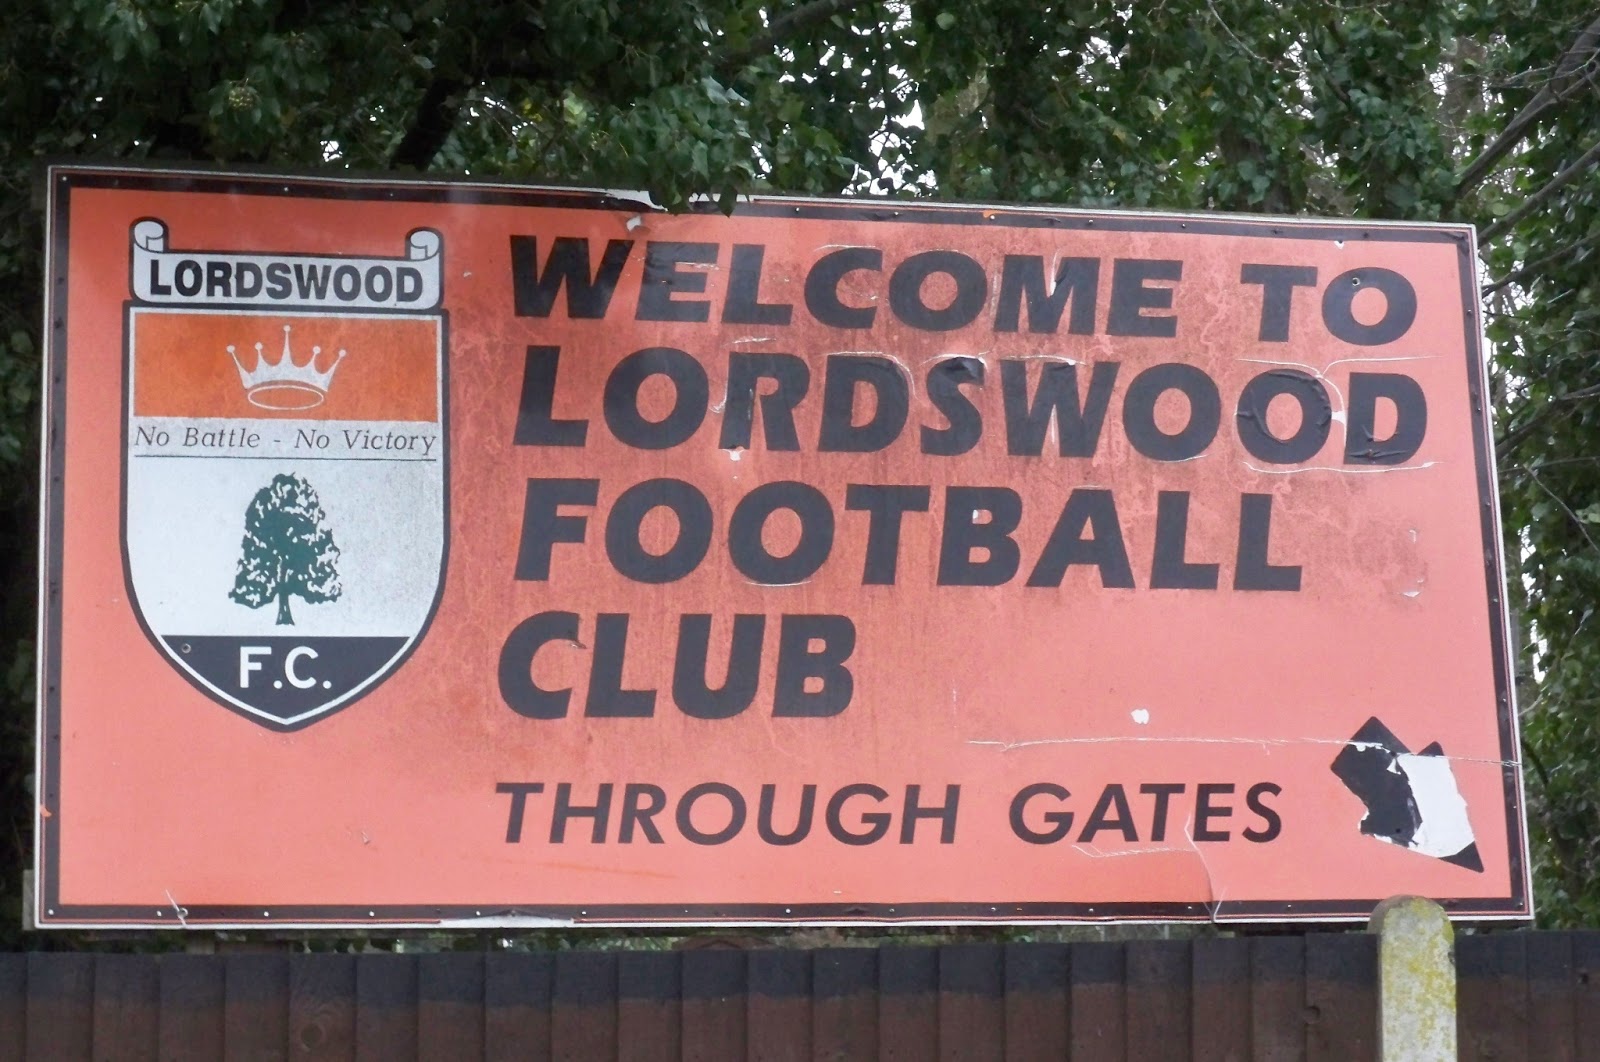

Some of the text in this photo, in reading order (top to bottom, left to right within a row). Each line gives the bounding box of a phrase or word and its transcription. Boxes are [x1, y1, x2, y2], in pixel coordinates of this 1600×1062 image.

[150, 259, 423, 302] LORDSWOOD
[510, 235, 1418, 346] WELCOME TO
[134, 426, 170, 447] No
[182, 427, 261, 448] Battle
[294, 429, 331, 450] No
[343, 430, 437, 456] Victory
[513, 345, 1428, 465] LORDSWOOD
[514, 478, 1303, 591] FOOTBALL
[239, 646, 332, 689] F.C.
[497, 610, 857, 720] CLUB
[496, 782, 1283, 846] THROUGH GATES
